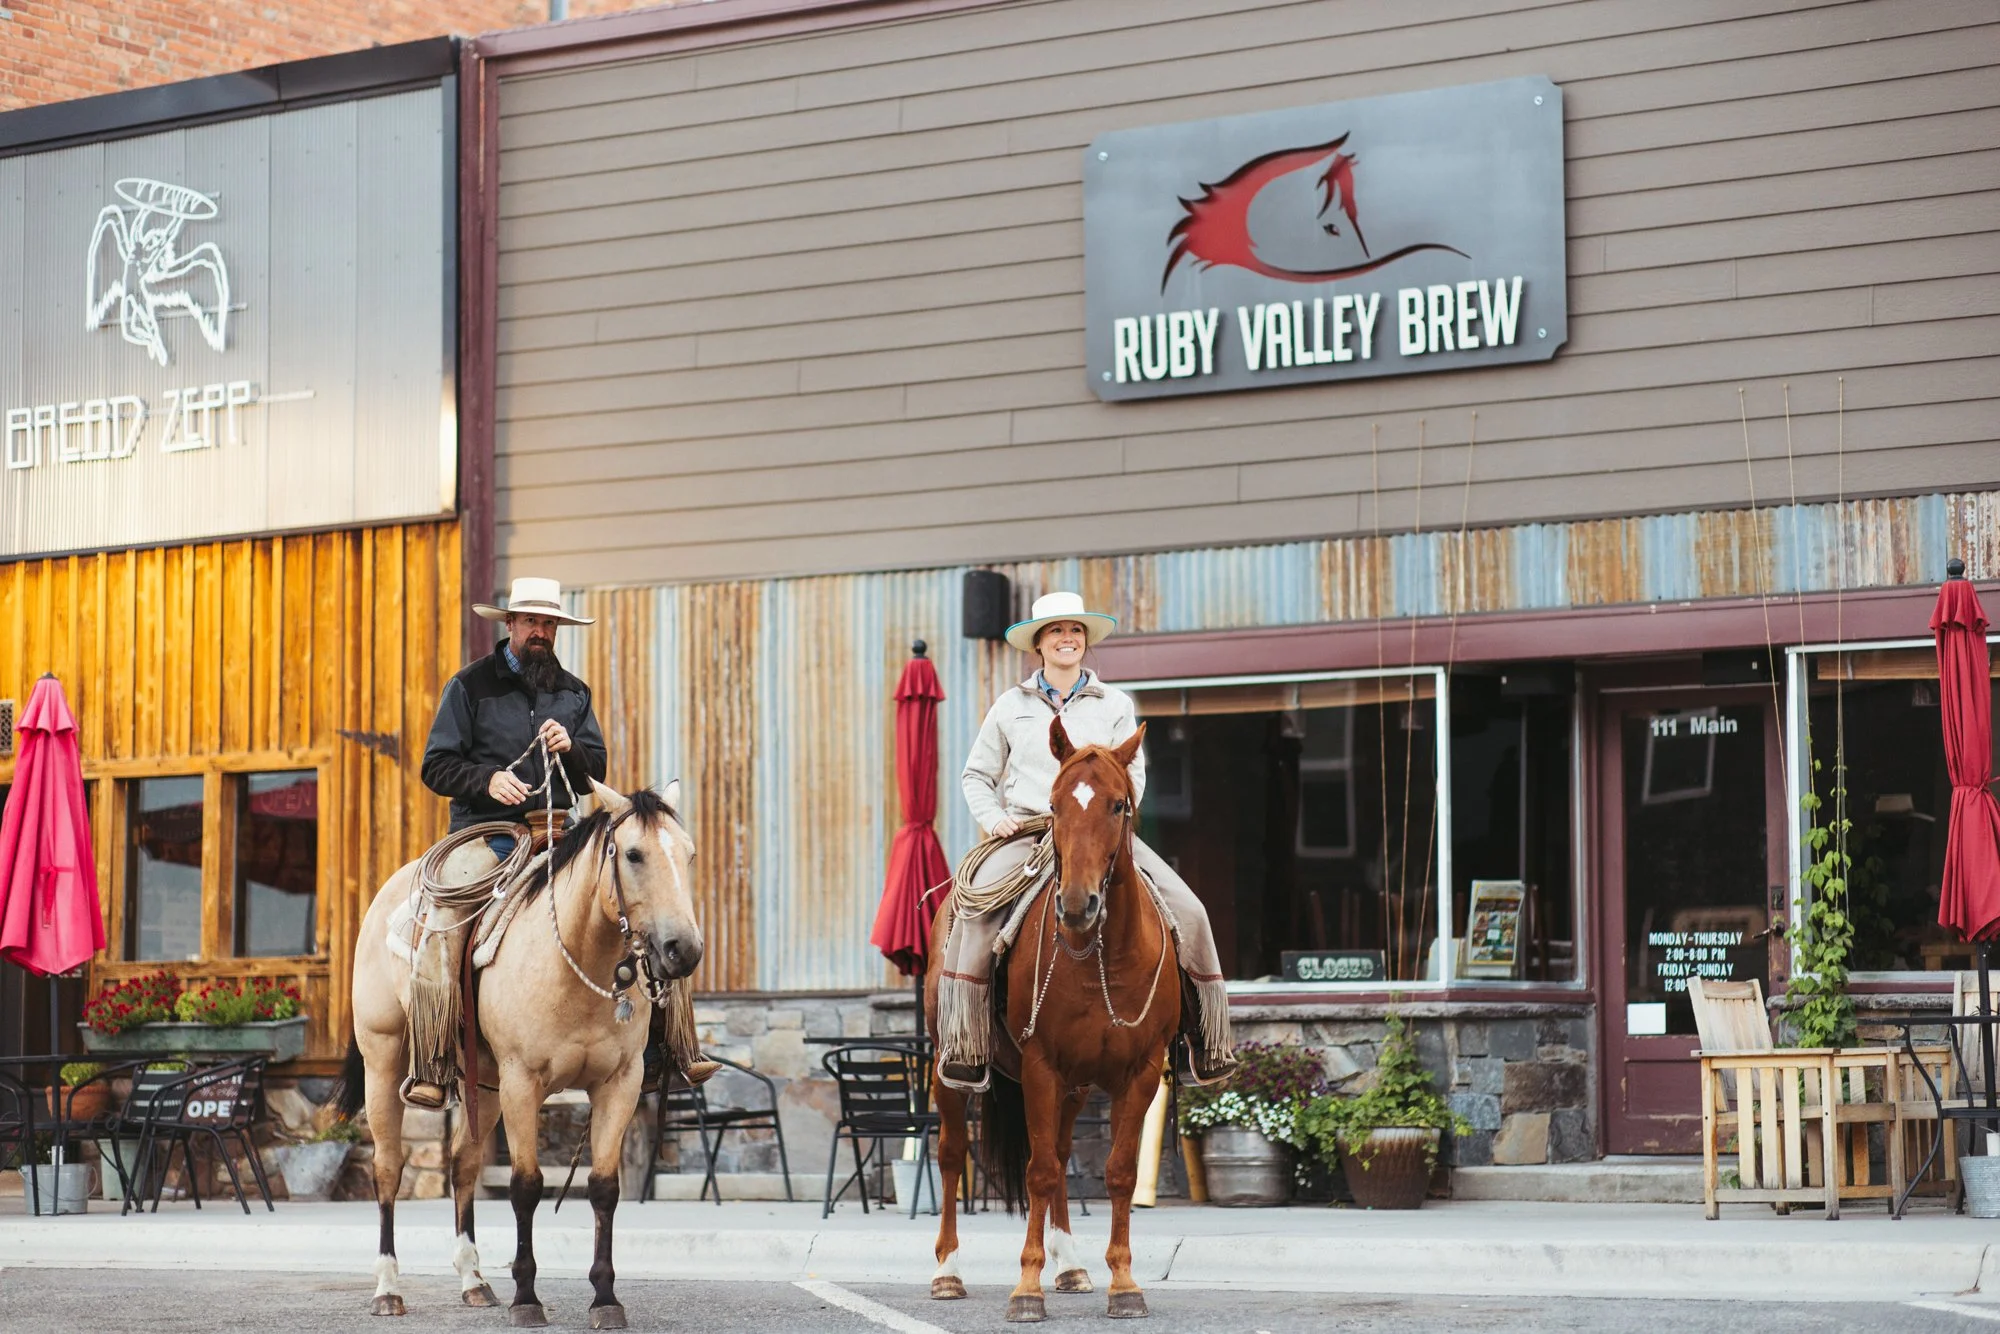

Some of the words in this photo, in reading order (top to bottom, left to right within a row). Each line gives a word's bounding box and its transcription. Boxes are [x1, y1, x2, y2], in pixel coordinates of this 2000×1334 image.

[1114, 307, 1219, 383] RUBY
[1237, 292, 1381, 371] VALLEY
[1398, 275, 1523, 356] BREW
[7, 394, 145, 470] BREAD
[161, 379, 251, 453] ZEPP
[1651, 718, 1677, 737] 111
[1690, 715, 1738, 735] Main
[1649, 931, 1743, 946] MONDAY-THURSDAY
[1666, 947, 1708, 961] 2:00-8:00
[1711, 947, 1727, 961] PM
[1297, 957, 1374, 980] CLOSED
[1657, 962, 1734, 977] FRIDAY-SUNDAY
[187, 1100, 240, 1118] OPE
